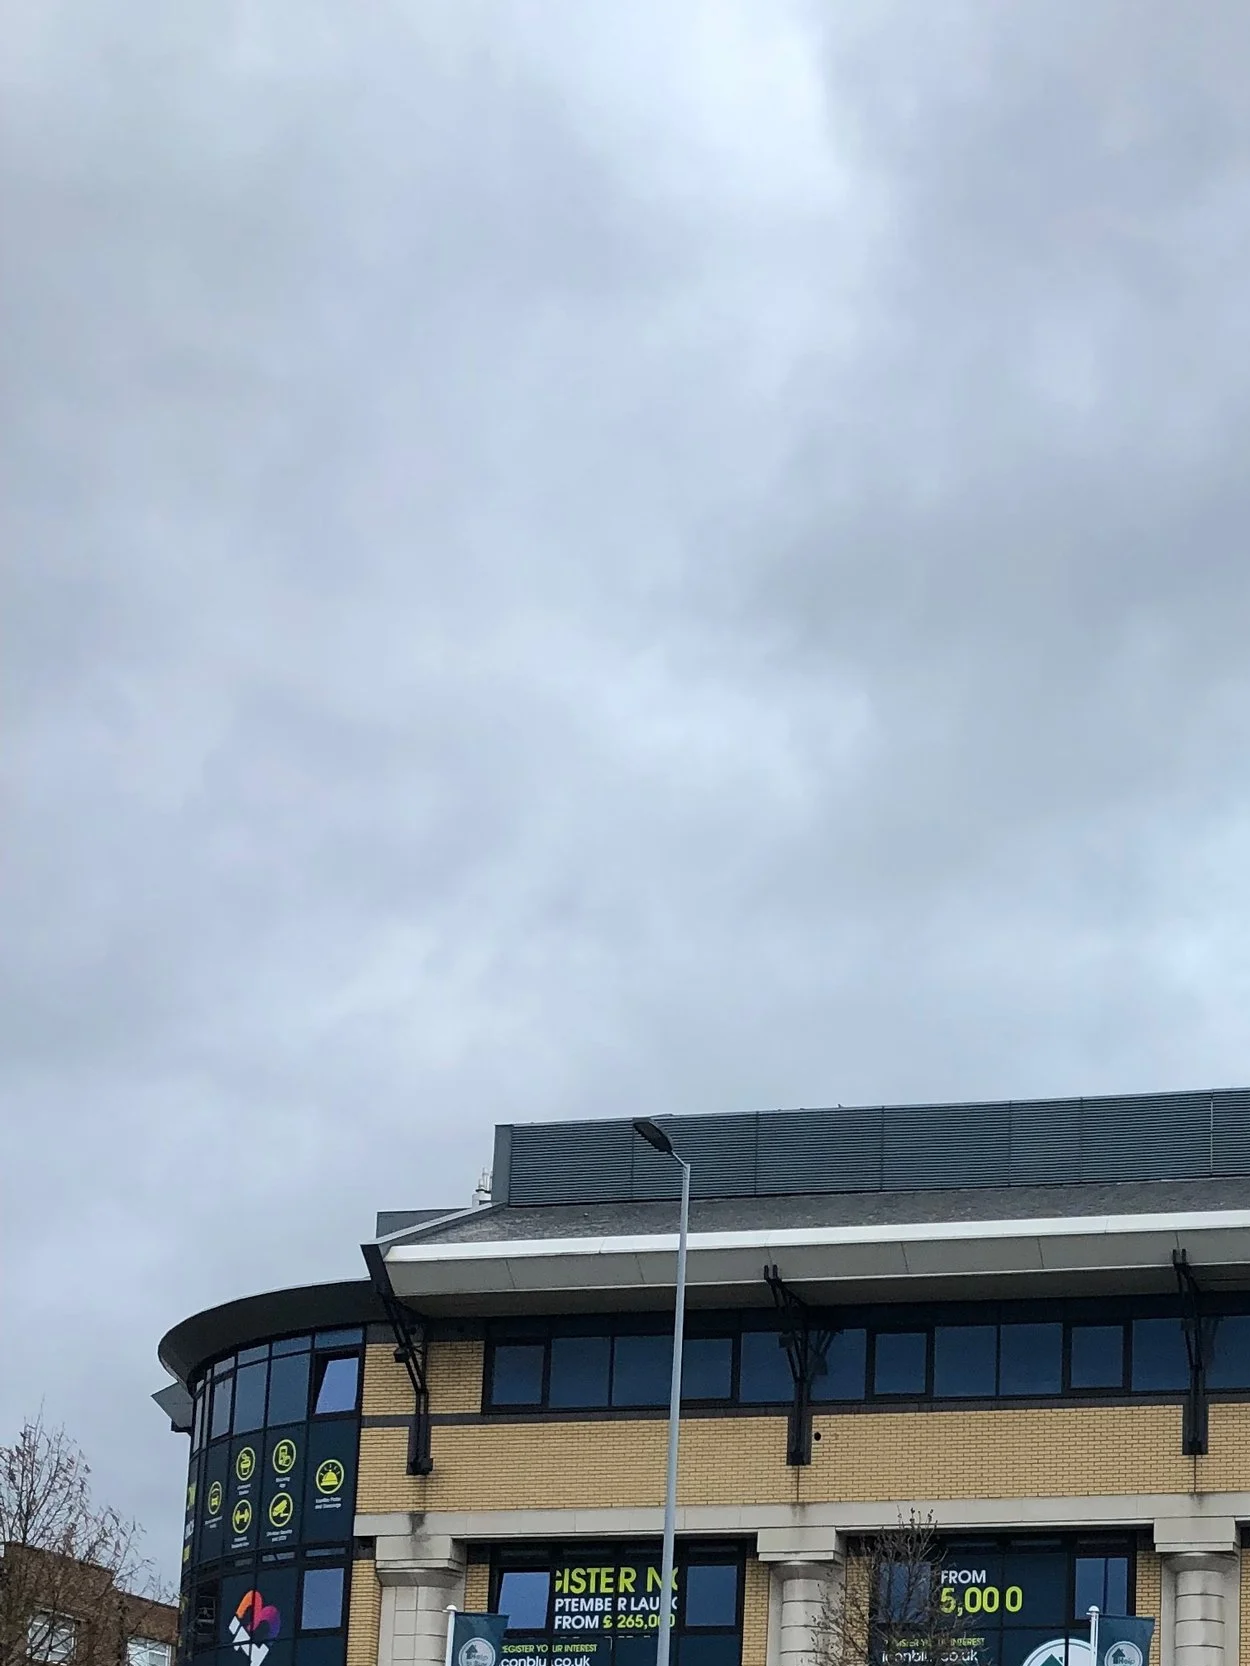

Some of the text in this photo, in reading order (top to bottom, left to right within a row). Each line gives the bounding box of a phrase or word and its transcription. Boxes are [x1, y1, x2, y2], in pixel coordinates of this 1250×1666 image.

[941, 1570, 986, 1584] FROM
[940, 1586, 1023, 1616] 5,000
[554, 1615, 600, 1630] FROM
[564, 1644, 597, 1653] INTEREST
[1117, 1657, 1135, 1665] Help
